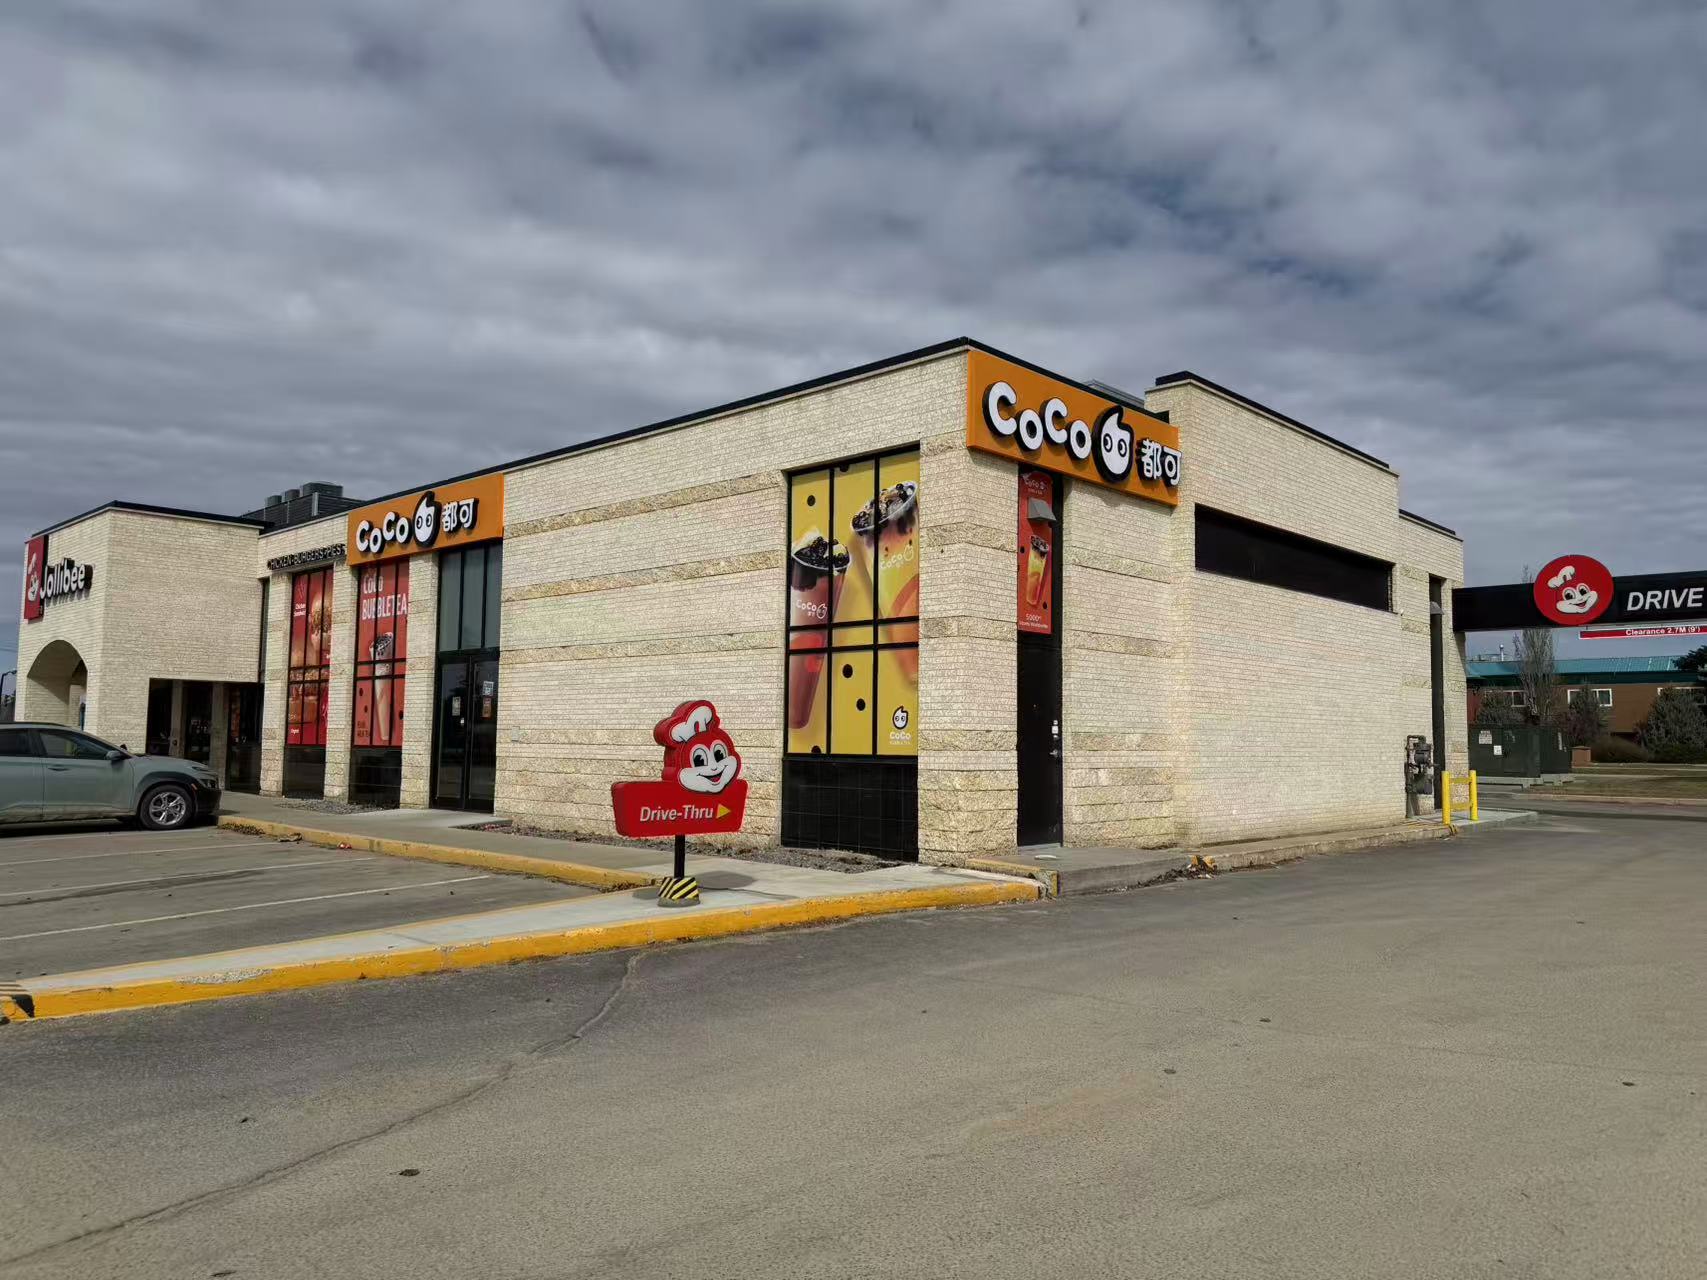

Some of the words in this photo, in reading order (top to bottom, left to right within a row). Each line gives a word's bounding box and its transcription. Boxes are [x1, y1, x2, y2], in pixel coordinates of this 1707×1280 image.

[1140, 438, 1182, 486] 都可
[441, 498, 475, 532] 都可
[40, 557, 87, 599] Jollibee
[1627, 587, 1705, 612] DRIVE
[1625, 628, 1665, 636] Clearance
[1667, 626, 1687, 634] 2.7M
[640, 804, 714, 822] Drive-Thru
